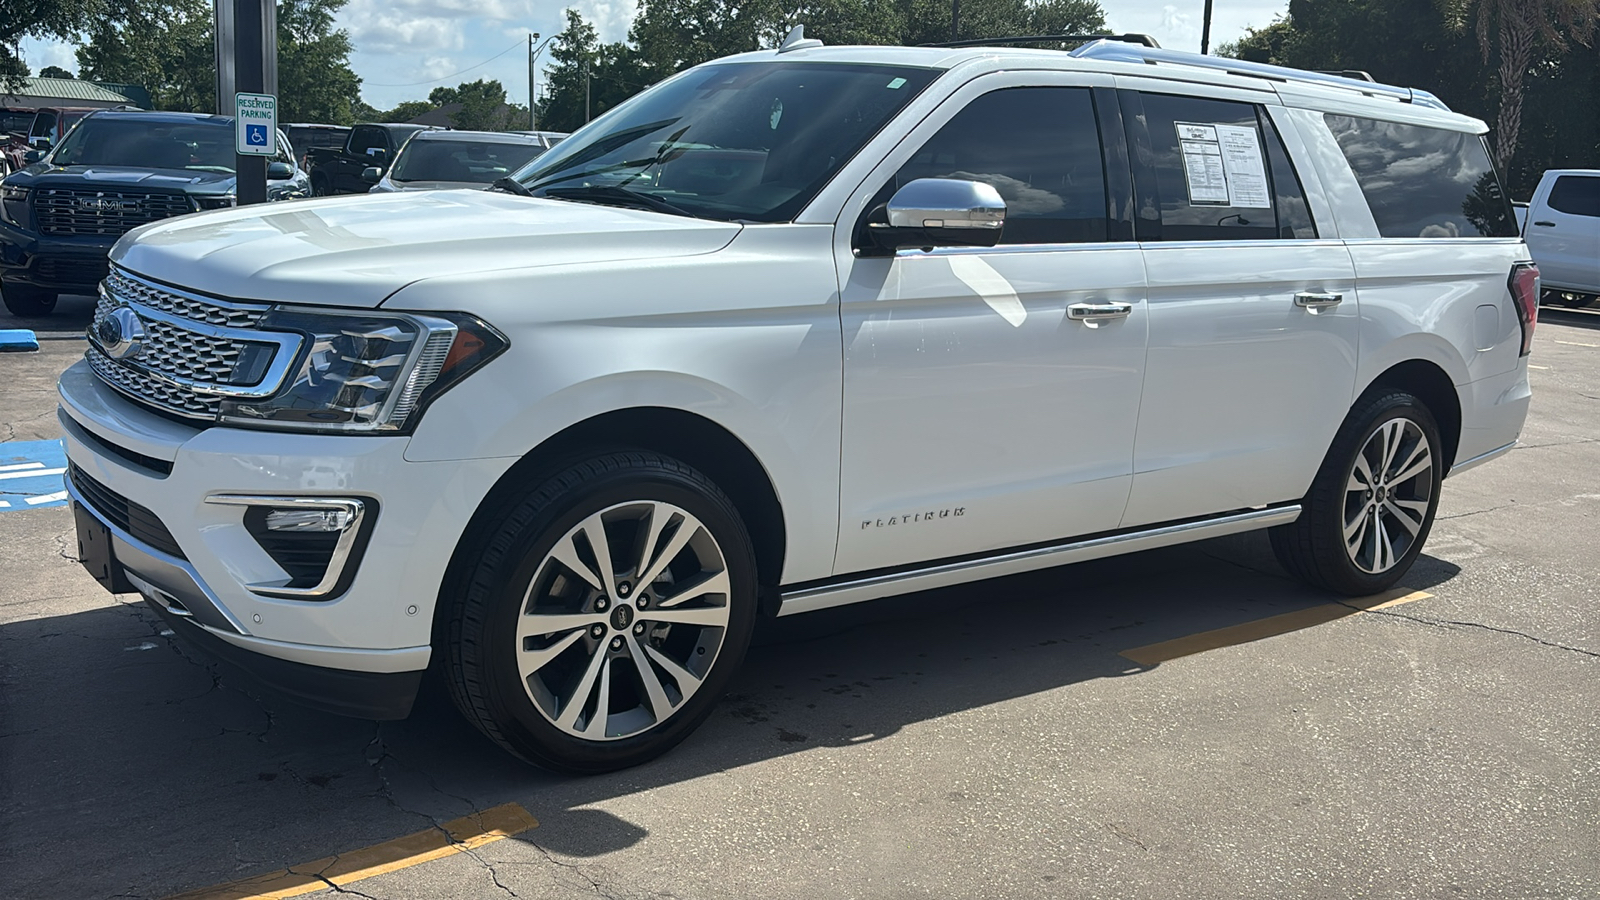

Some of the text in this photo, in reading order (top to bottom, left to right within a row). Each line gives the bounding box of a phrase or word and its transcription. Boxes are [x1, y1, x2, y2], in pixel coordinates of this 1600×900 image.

[238, 99, 274, 109] RESERVED
[241, 109, 272, 119] PARKING
[82, 199, 136, 212] GMC
[861, 507, 965, 530] PLATINUM
